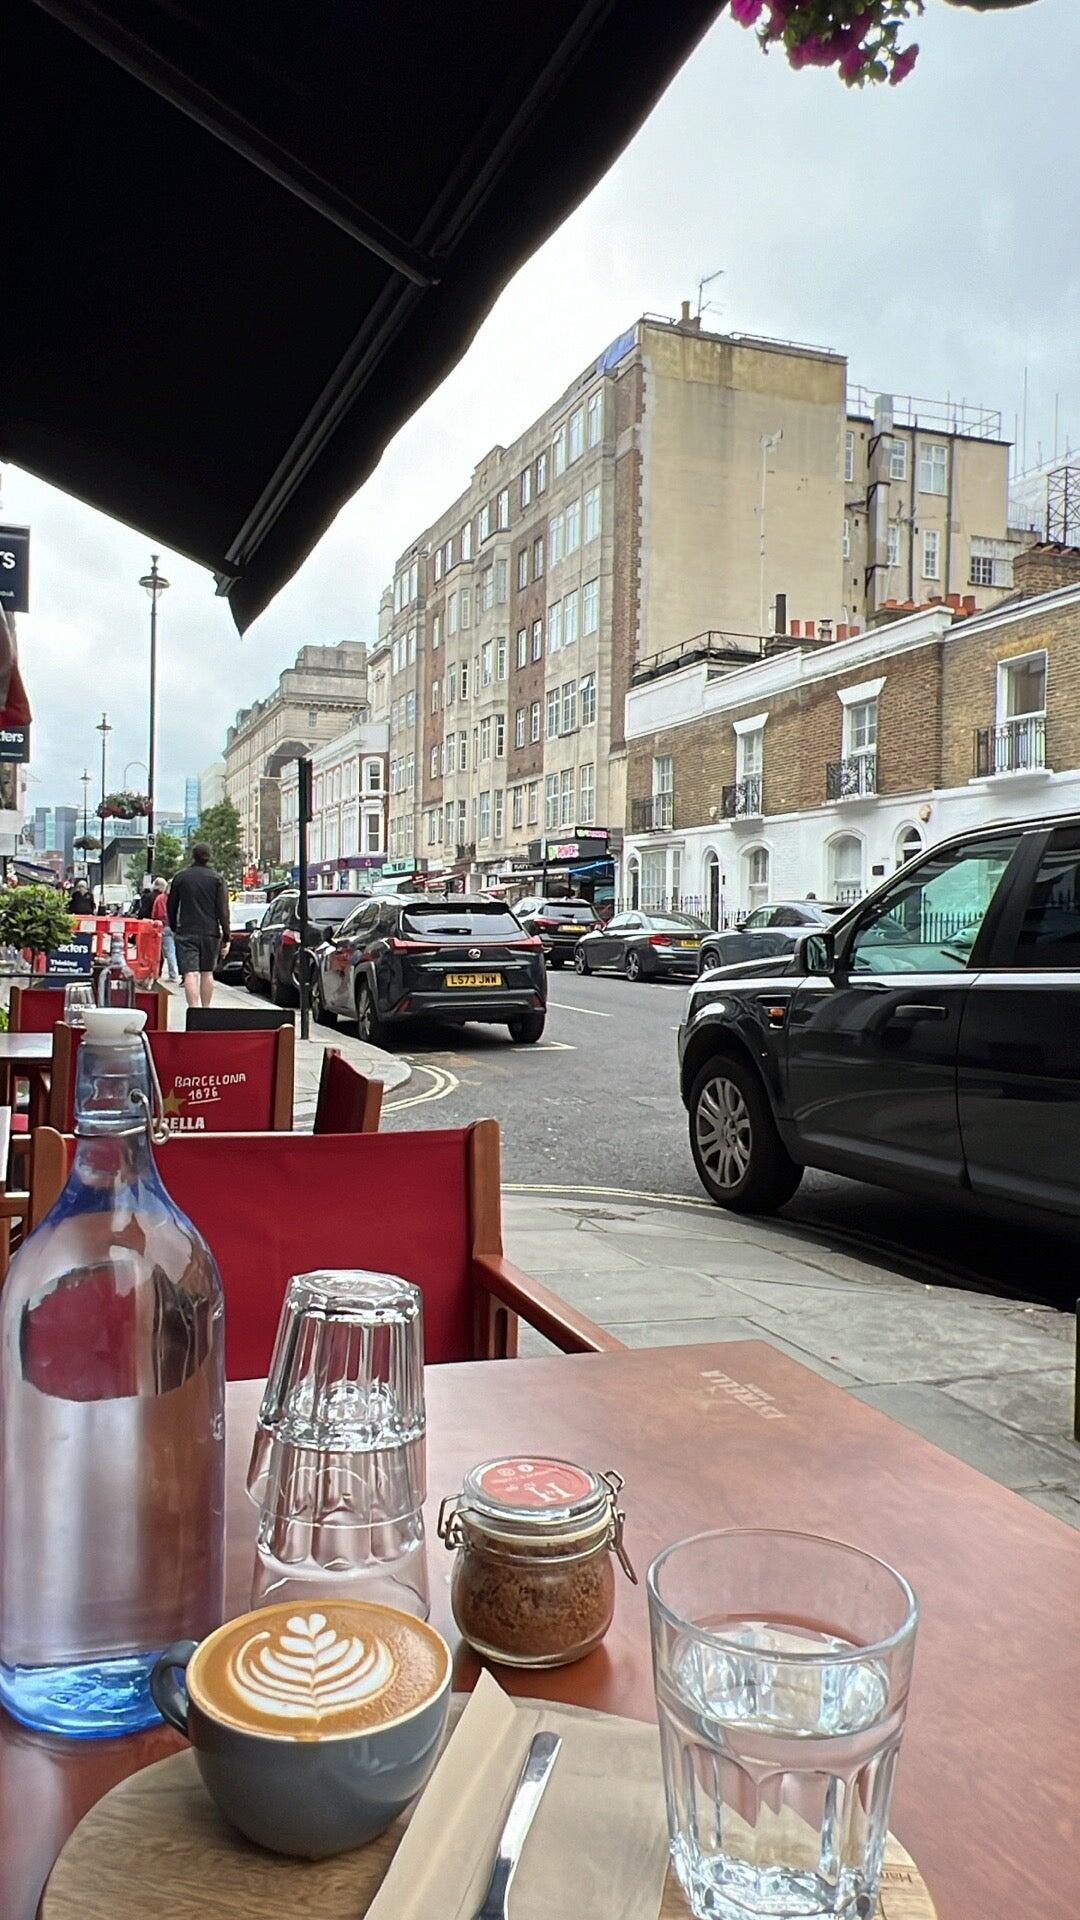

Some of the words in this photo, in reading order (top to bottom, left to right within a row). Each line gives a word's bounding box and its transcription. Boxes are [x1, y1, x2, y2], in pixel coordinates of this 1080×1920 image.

[451, 975, 476, 985] LS73
[174, 1072, 247, 1088] BARCELONA
[188, 1086, 219, 1101] 1876
